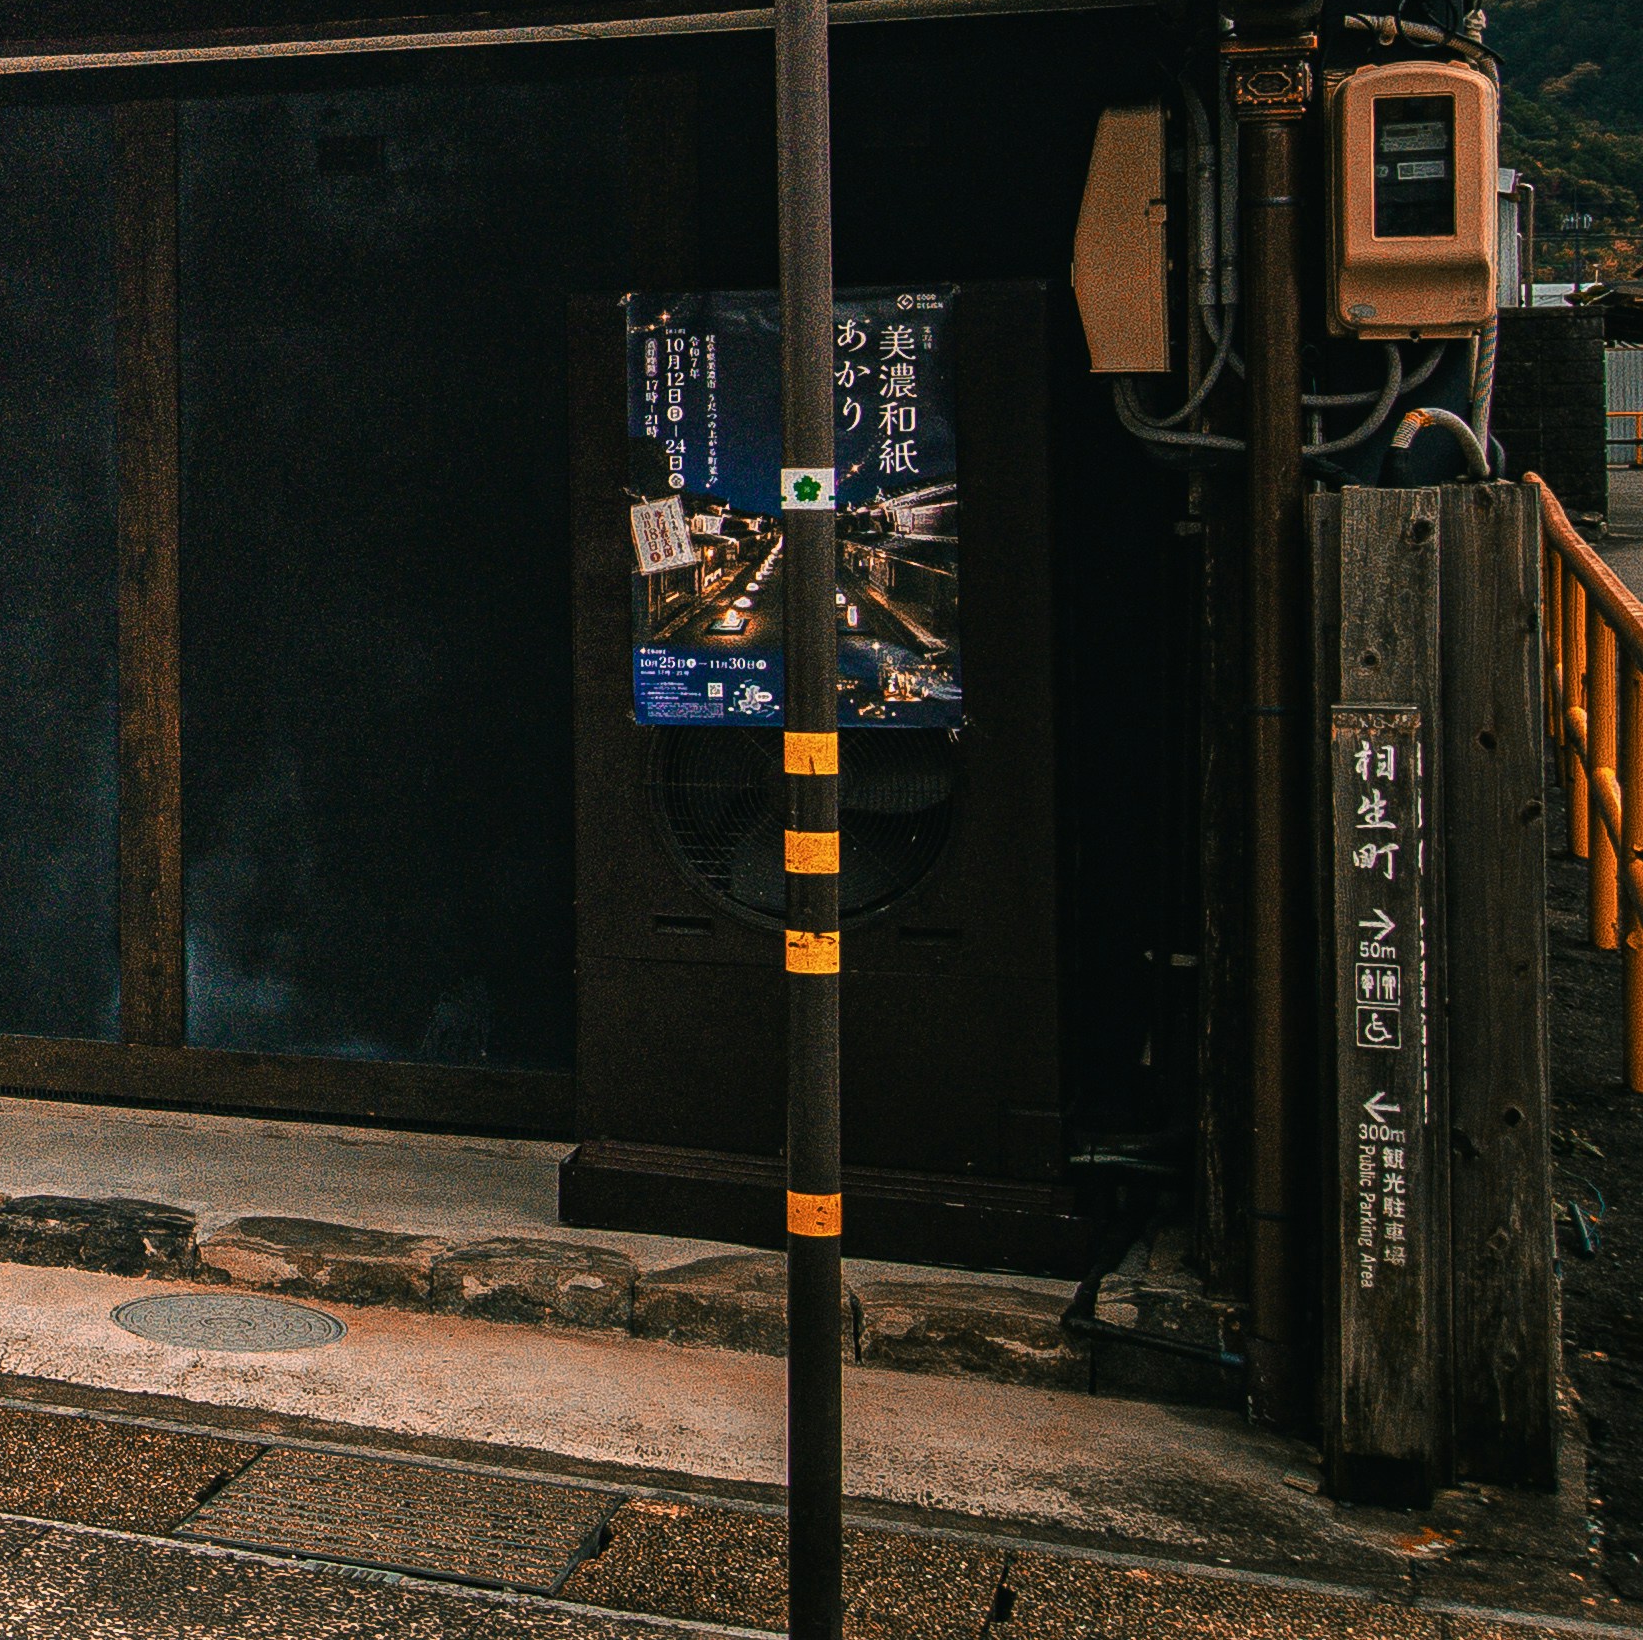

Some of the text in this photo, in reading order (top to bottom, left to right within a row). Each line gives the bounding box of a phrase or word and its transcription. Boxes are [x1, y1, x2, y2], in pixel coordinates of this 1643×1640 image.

[878, 323, 920, 475] 美濃和紙
[1352, 740, 1399, 881] 相生町
[1359, 940, 1397, 960] 50m
[1358, 1123, 1407, 1145] 300m
[1357, 1144, 1378, 1289] Public Parking Area
[1381, 1146, 1408, 1267] 観光駐車場
